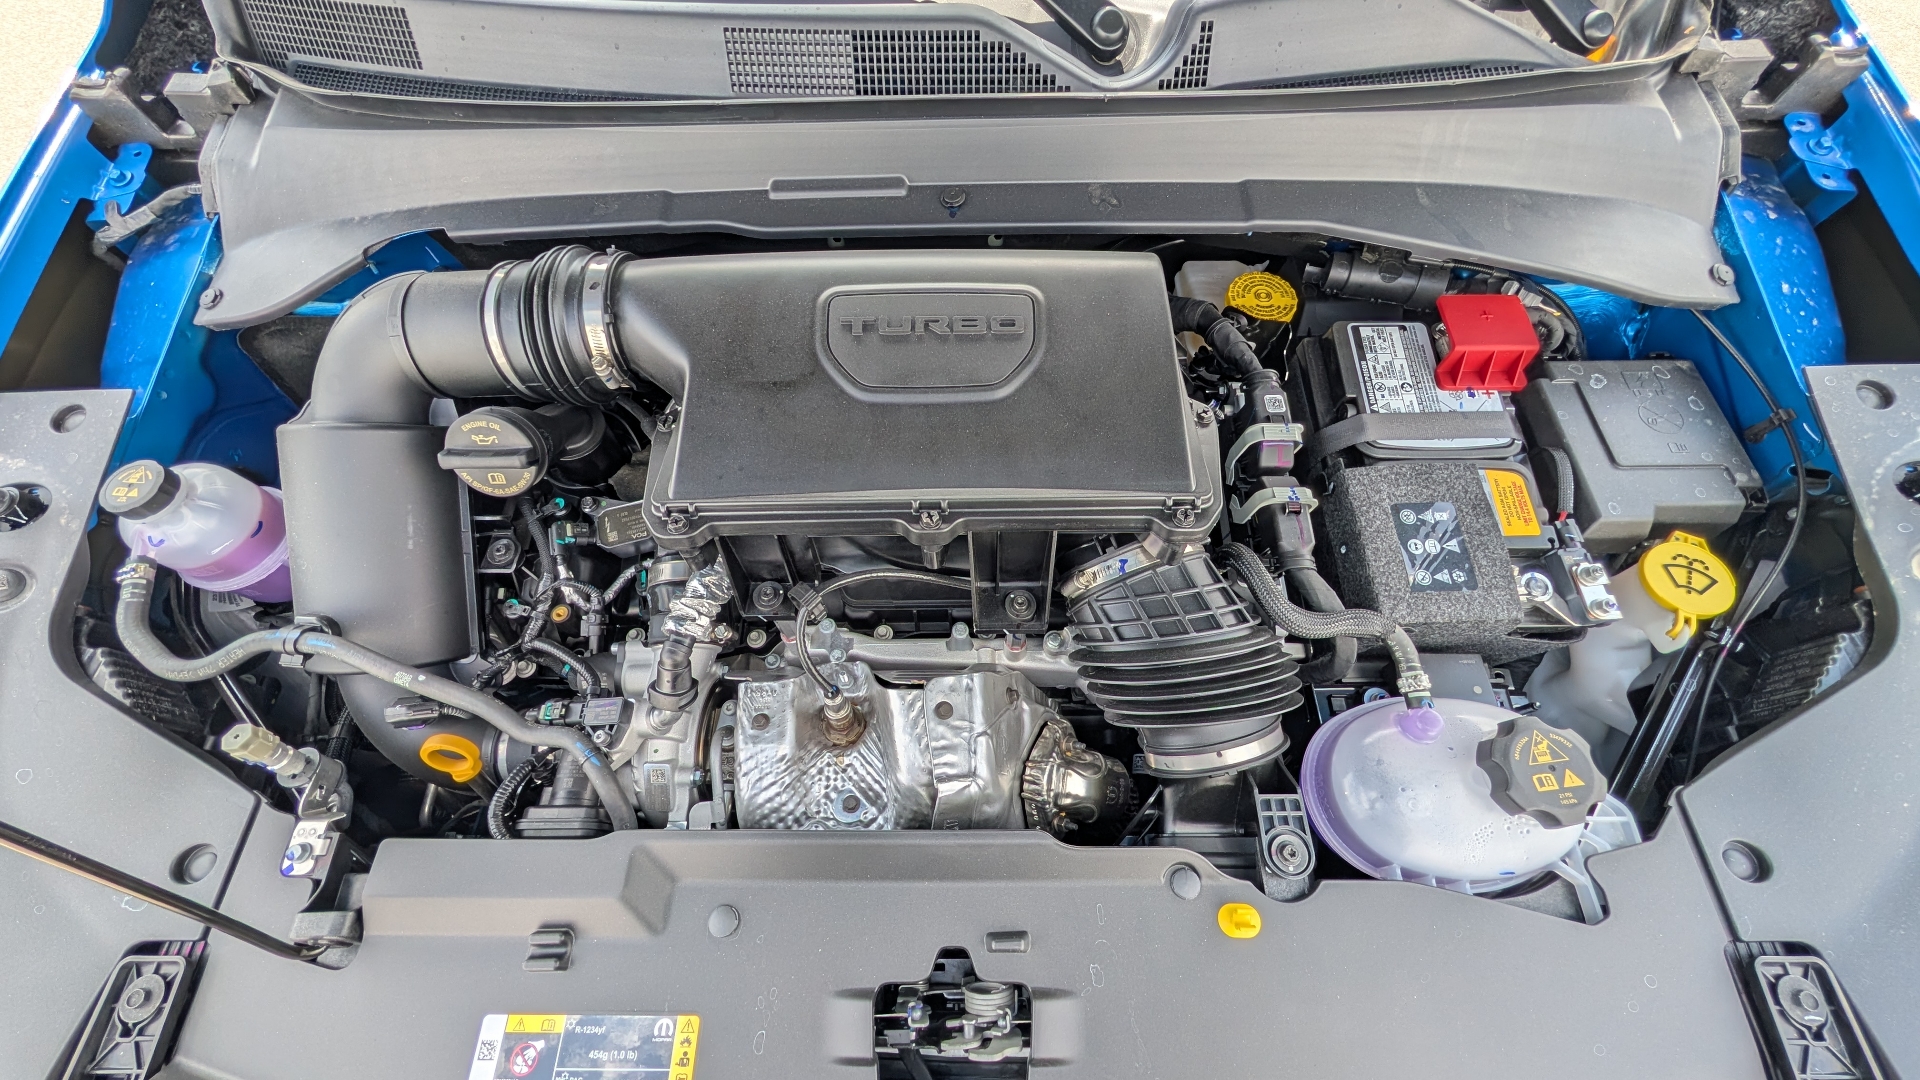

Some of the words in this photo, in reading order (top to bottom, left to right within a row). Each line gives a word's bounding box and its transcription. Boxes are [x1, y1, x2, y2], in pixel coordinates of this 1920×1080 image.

[839, 315, 1025, 335] TURBO
[1360, 361, 1376, 403] DANGER/POISON
[461, 421, 488, 432] ENGINE
[489, 422, 501, 432] OIL
[460, 472, 472, 483] API
[1501, 487, 1509, 500] OPEN
[631, 530, 648, 539] FCA
[574, 1026, 606, 1034] R-1234yf
[588, 1050, 608, 1060] 454g
[610, 1050, 626, 1060] (1.0
[627, 1050, 638, 1060] lb)
